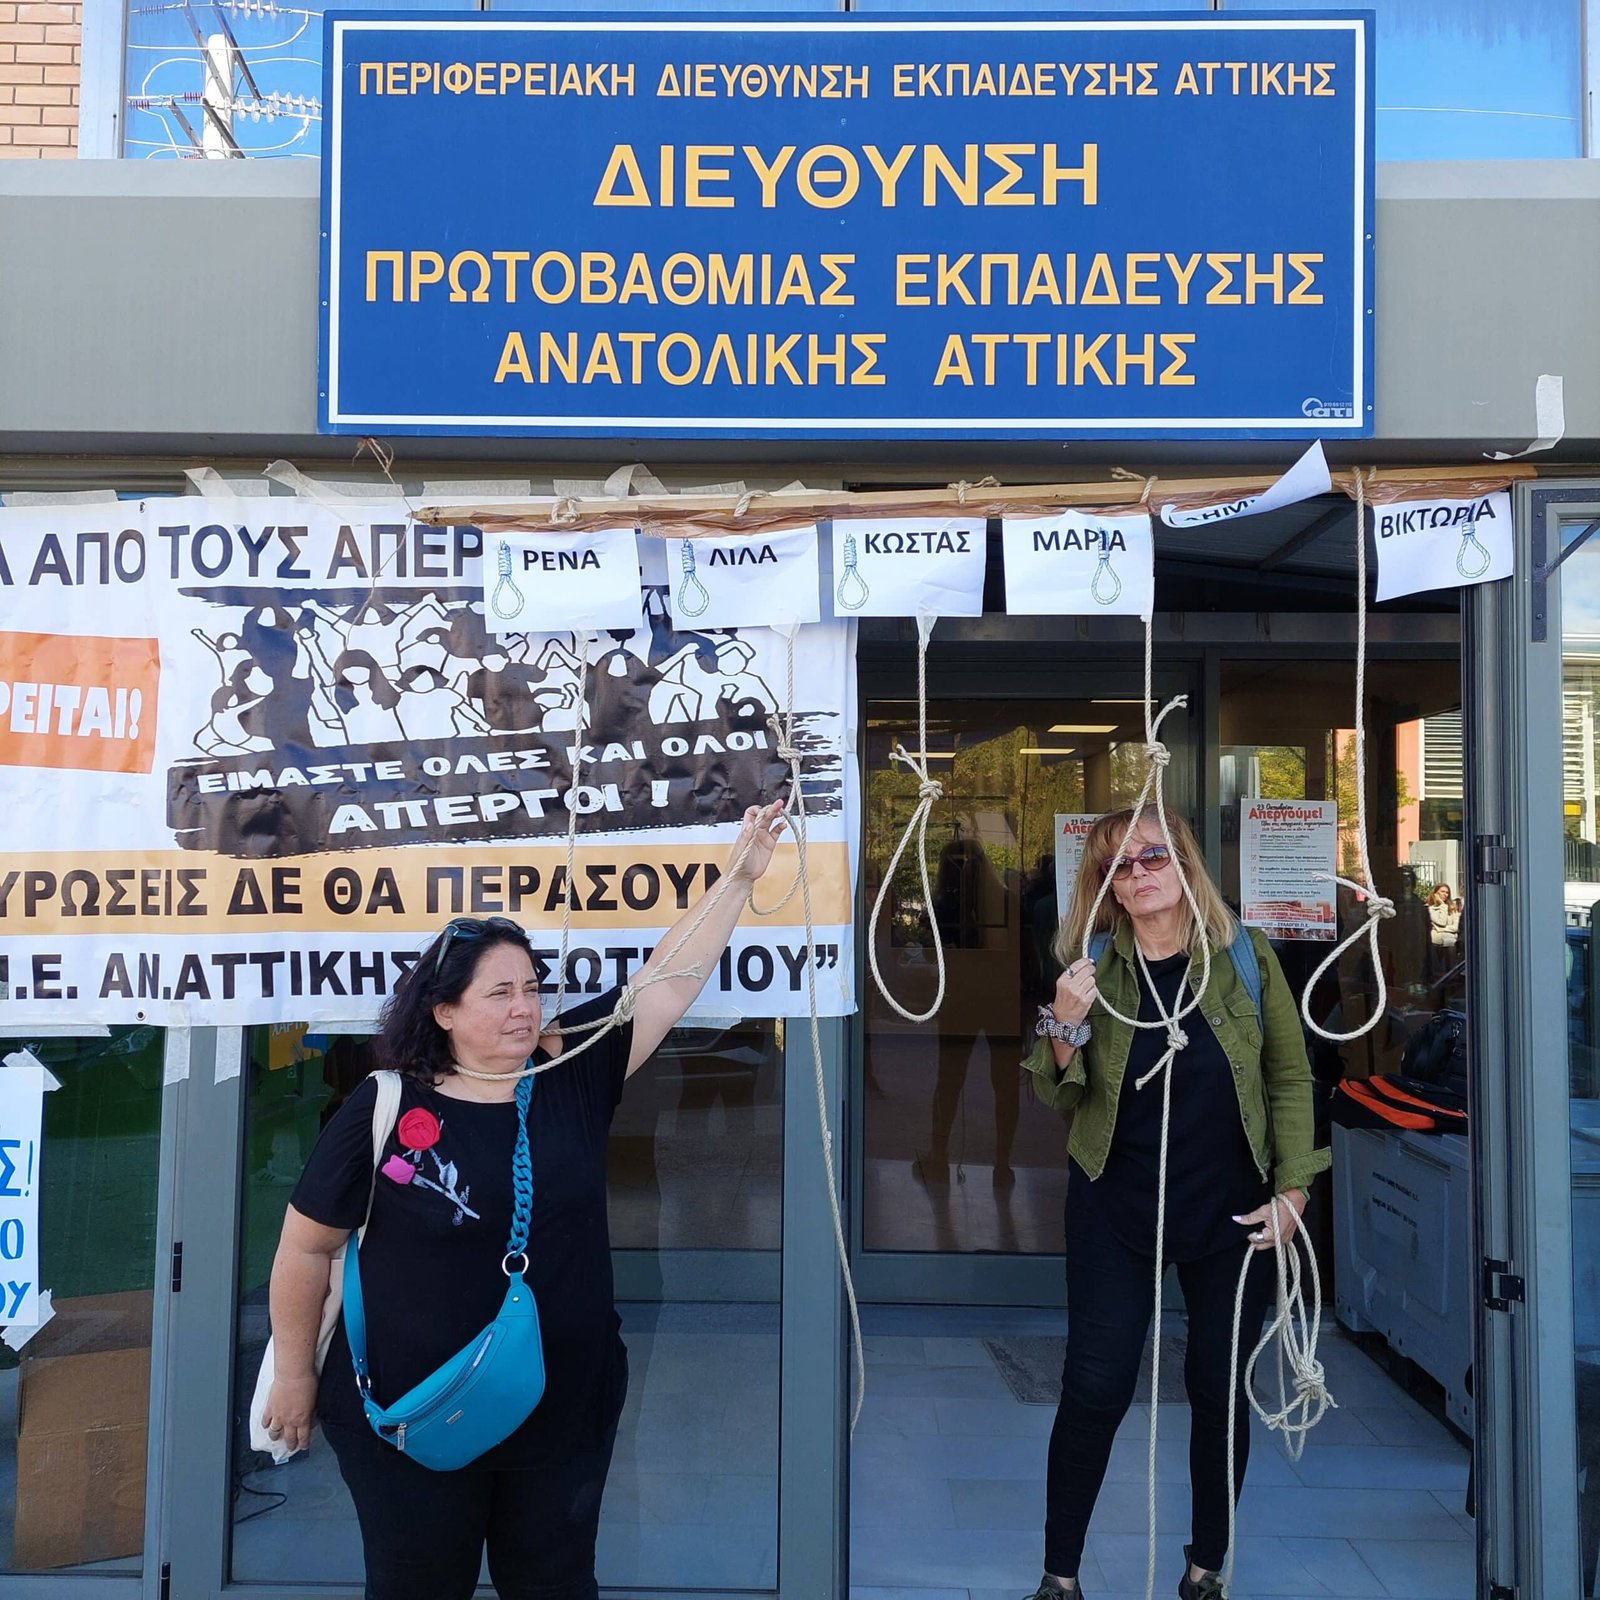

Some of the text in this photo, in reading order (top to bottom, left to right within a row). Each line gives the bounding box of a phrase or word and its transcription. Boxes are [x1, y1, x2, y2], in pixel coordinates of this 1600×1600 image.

[360, 62, 1336, 98] ΠΕΡΙΦΕΡΕΙΑΚΗ ΔΙΕΥΘΥΝΣΗ ΕΚΠΑΙΔΕΥΣΗΣ ΑΤΤΙΚΗΣ
[593, 144, 1098, 208] ΔΙΕΥΘΥΝΣΗ
[366, 251, 1324, 306] ΠΡΩΤΟΒΑΘΜΙΑΣ ΕΚΠΑΙΔΕΥΣΗΣ
[494, 332, 1196, 386] ΑΝΑΤΟΛΙΚΗΣ ΑΤΤΙΚΗΣ
[1033, 528, 1127, 552] ΜΑΡΙΑ
[1380, 498, 1496, 538] ΒΙΚΤΩΡΙΑ
[29, 530, 146, 586] ΑΠΟ
[159, 525, 311, 579] ΤΟΥΣ
[327, 524, 484, 579] ΑΠΕΡ
[523, 549, 601, 571] ΡΕΝΑ
[709, 544, 778, 567] ΛΙΛΑ
[865, 531, 971, 554] ΚΩΣΤΑΣ
[198, 731, 769, 794] ΕΙΜΑΣΤΕ ΟΛΕΣ ΚΑΙ ΟΛΟΙ
[328, 783, 625, 835] ΑΠΕΡΓΟΙ
[227, 868, 303, 915] ΔΕ
[323, 867, 405, 914] ΘΑ
